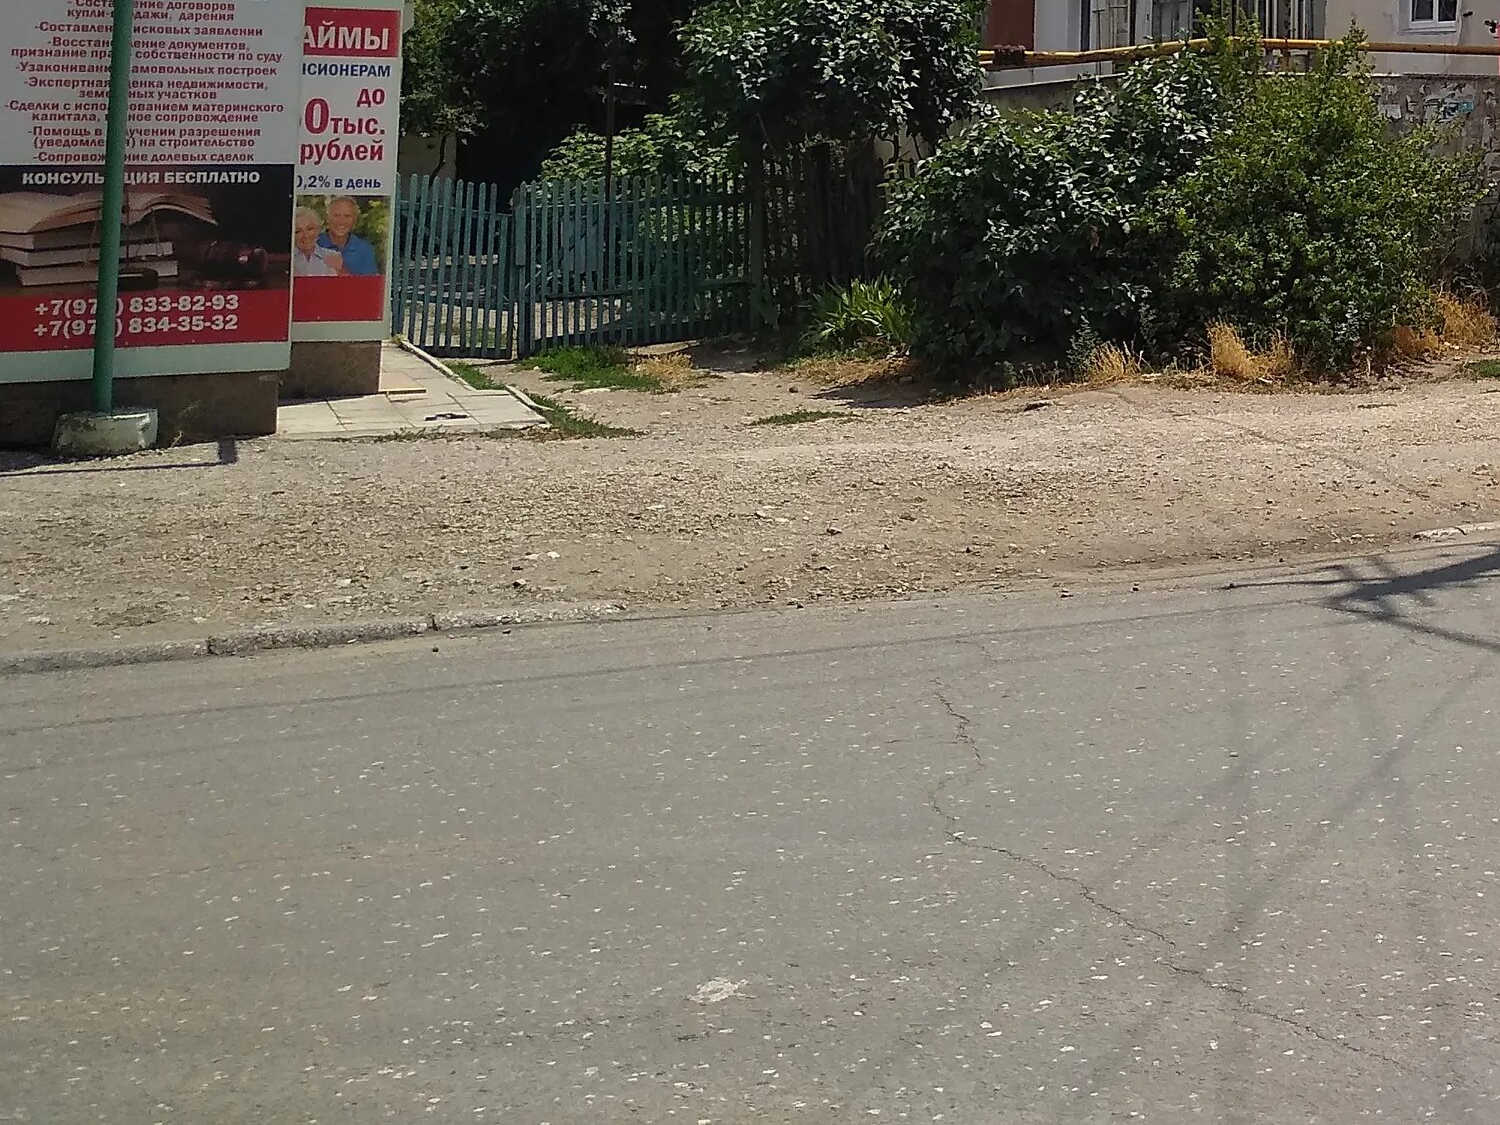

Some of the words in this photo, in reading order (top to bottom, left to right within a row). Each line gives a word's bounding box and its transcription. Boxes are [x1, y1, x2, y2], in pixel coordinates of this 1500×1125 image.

[166, 1, 235, 13] договоров
[178, 12, 235, 23] дарения
[303, 20, 390, 51] АЙМЫ
[11, 48, 87, 59] признание
[135, 49, 235, 61] собственности
[238, 52, 253, 61] по
[256, 53, 283, 63] суду
[131, 64, 215, 76] амовольных
[217, 67, 278, 77] построек
[302, 62, 391, 78] СИОНЕРАМ
[157, 90, 217, 101] участков
[63, 103, 71, 112] с
[74, 103, 189, 113] испоованием
[192, 104, 284, 114] материнского
[155, 113, 259, 124] сопровождение
[94, 128, 103, 137] в
[179, 128, 261, 139] разрешения
[139, 139, 156, 148] на
[159, 138, 255, 149] строительство
[150, 153, 208, 163] долевых
[210, 153, 254, 163] сделок
[300, 137, 384, 166] рублей
[21, 171, 160, 187] КОНСУЛЬЦИЯ
[163, 171, 261, 185] БЕСПЛАТНО
[334, 177, 344, 189] в
[346, 177, 382, 191] день
[35, 298, 124, 318] +7(97)
[129, 294, 239, 314] 833-82-93
[34, 319, 123, 339] +7(97)
[128, 314, 238, 334] 834-35-32
